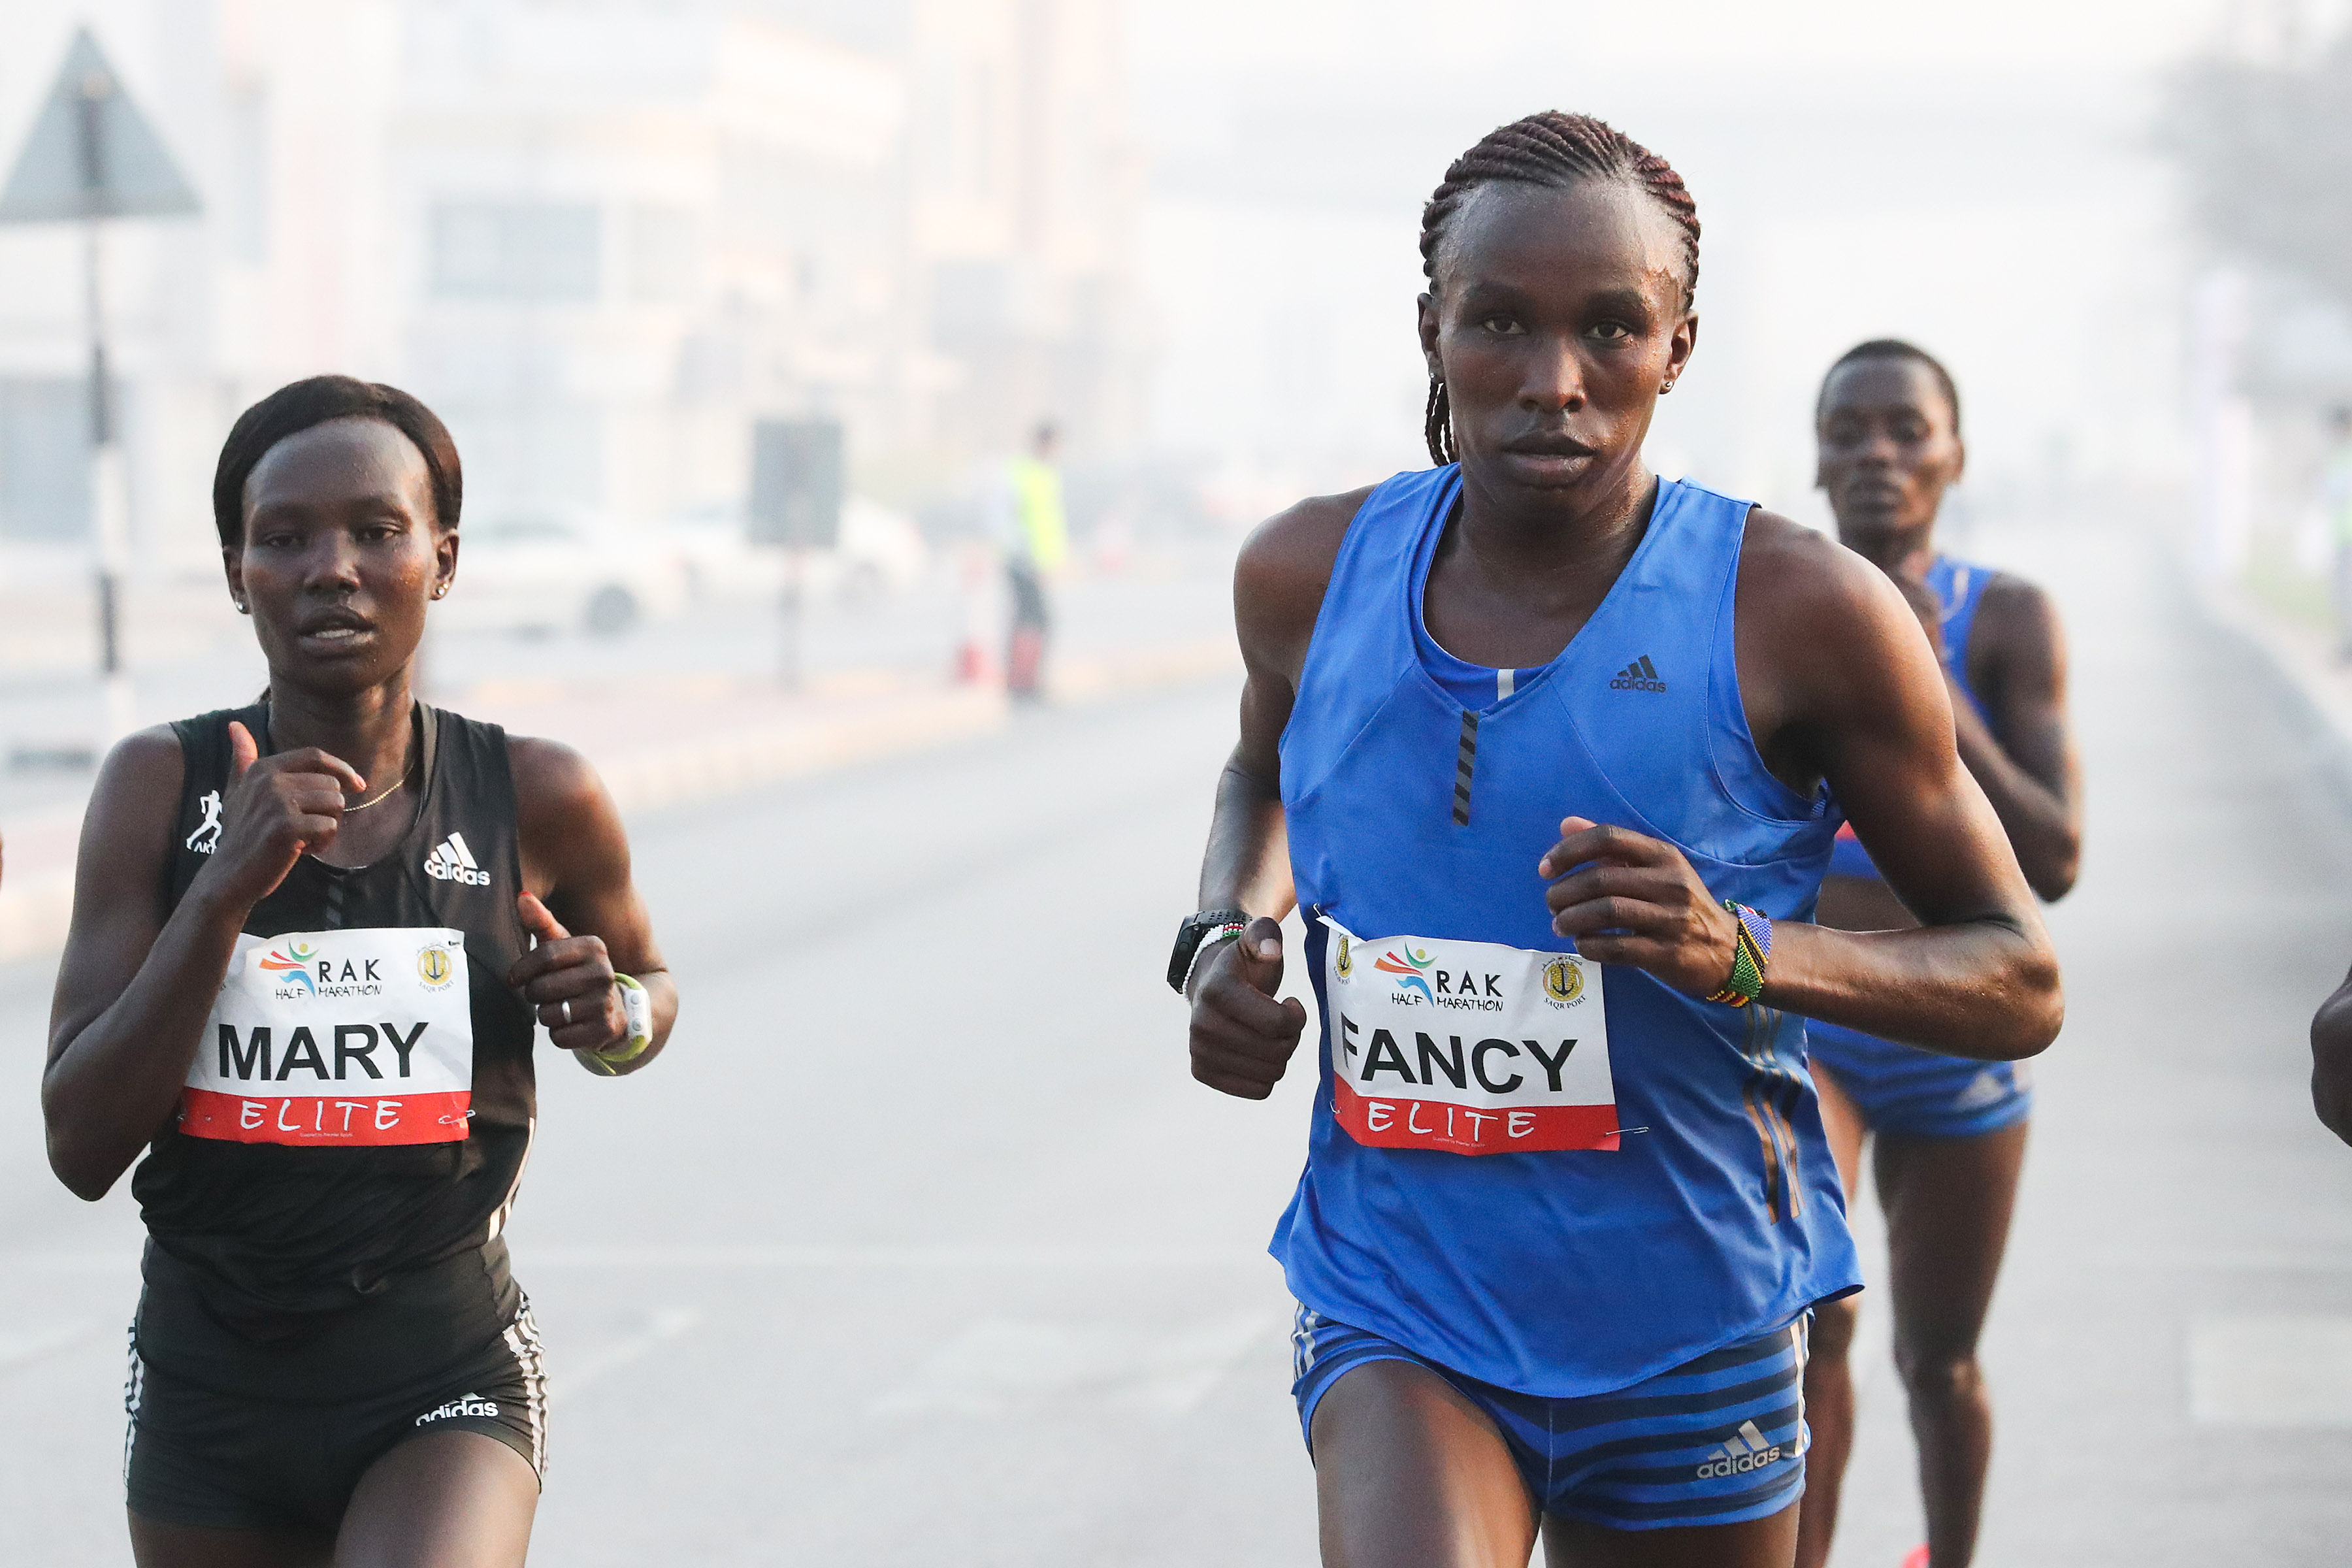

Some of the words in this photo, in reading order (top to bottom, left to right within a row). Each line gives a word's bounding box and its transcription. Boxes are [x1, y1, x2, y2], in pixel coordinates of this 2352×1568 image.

[1610, 677, 1667, 693] adidas
[423, 859, 490, 887] adidas
[319, 958, 382, 983] RAK
[1437, 970, 1503, 998] RAK
[276, 988, 305, 1000] HALF
[319, 985, 382, 998] MARATHON
[1392, 992, 1423, 1006] HALF
[1437, 996, 1503, 1012] MARATHON
[1543, 997, 1565, 1011] SAQR
[1566, 994, 1587, 1009] PORT
[218, 1022, 429, 1081] MARY
[1341, 1011, 1578, 1094] FANCY
[240, 1099, 402, 1132] ELITE
[1367, 1102, 1537, 1143] ELITE
[1696, 1446, 1780, 1479] adidas
